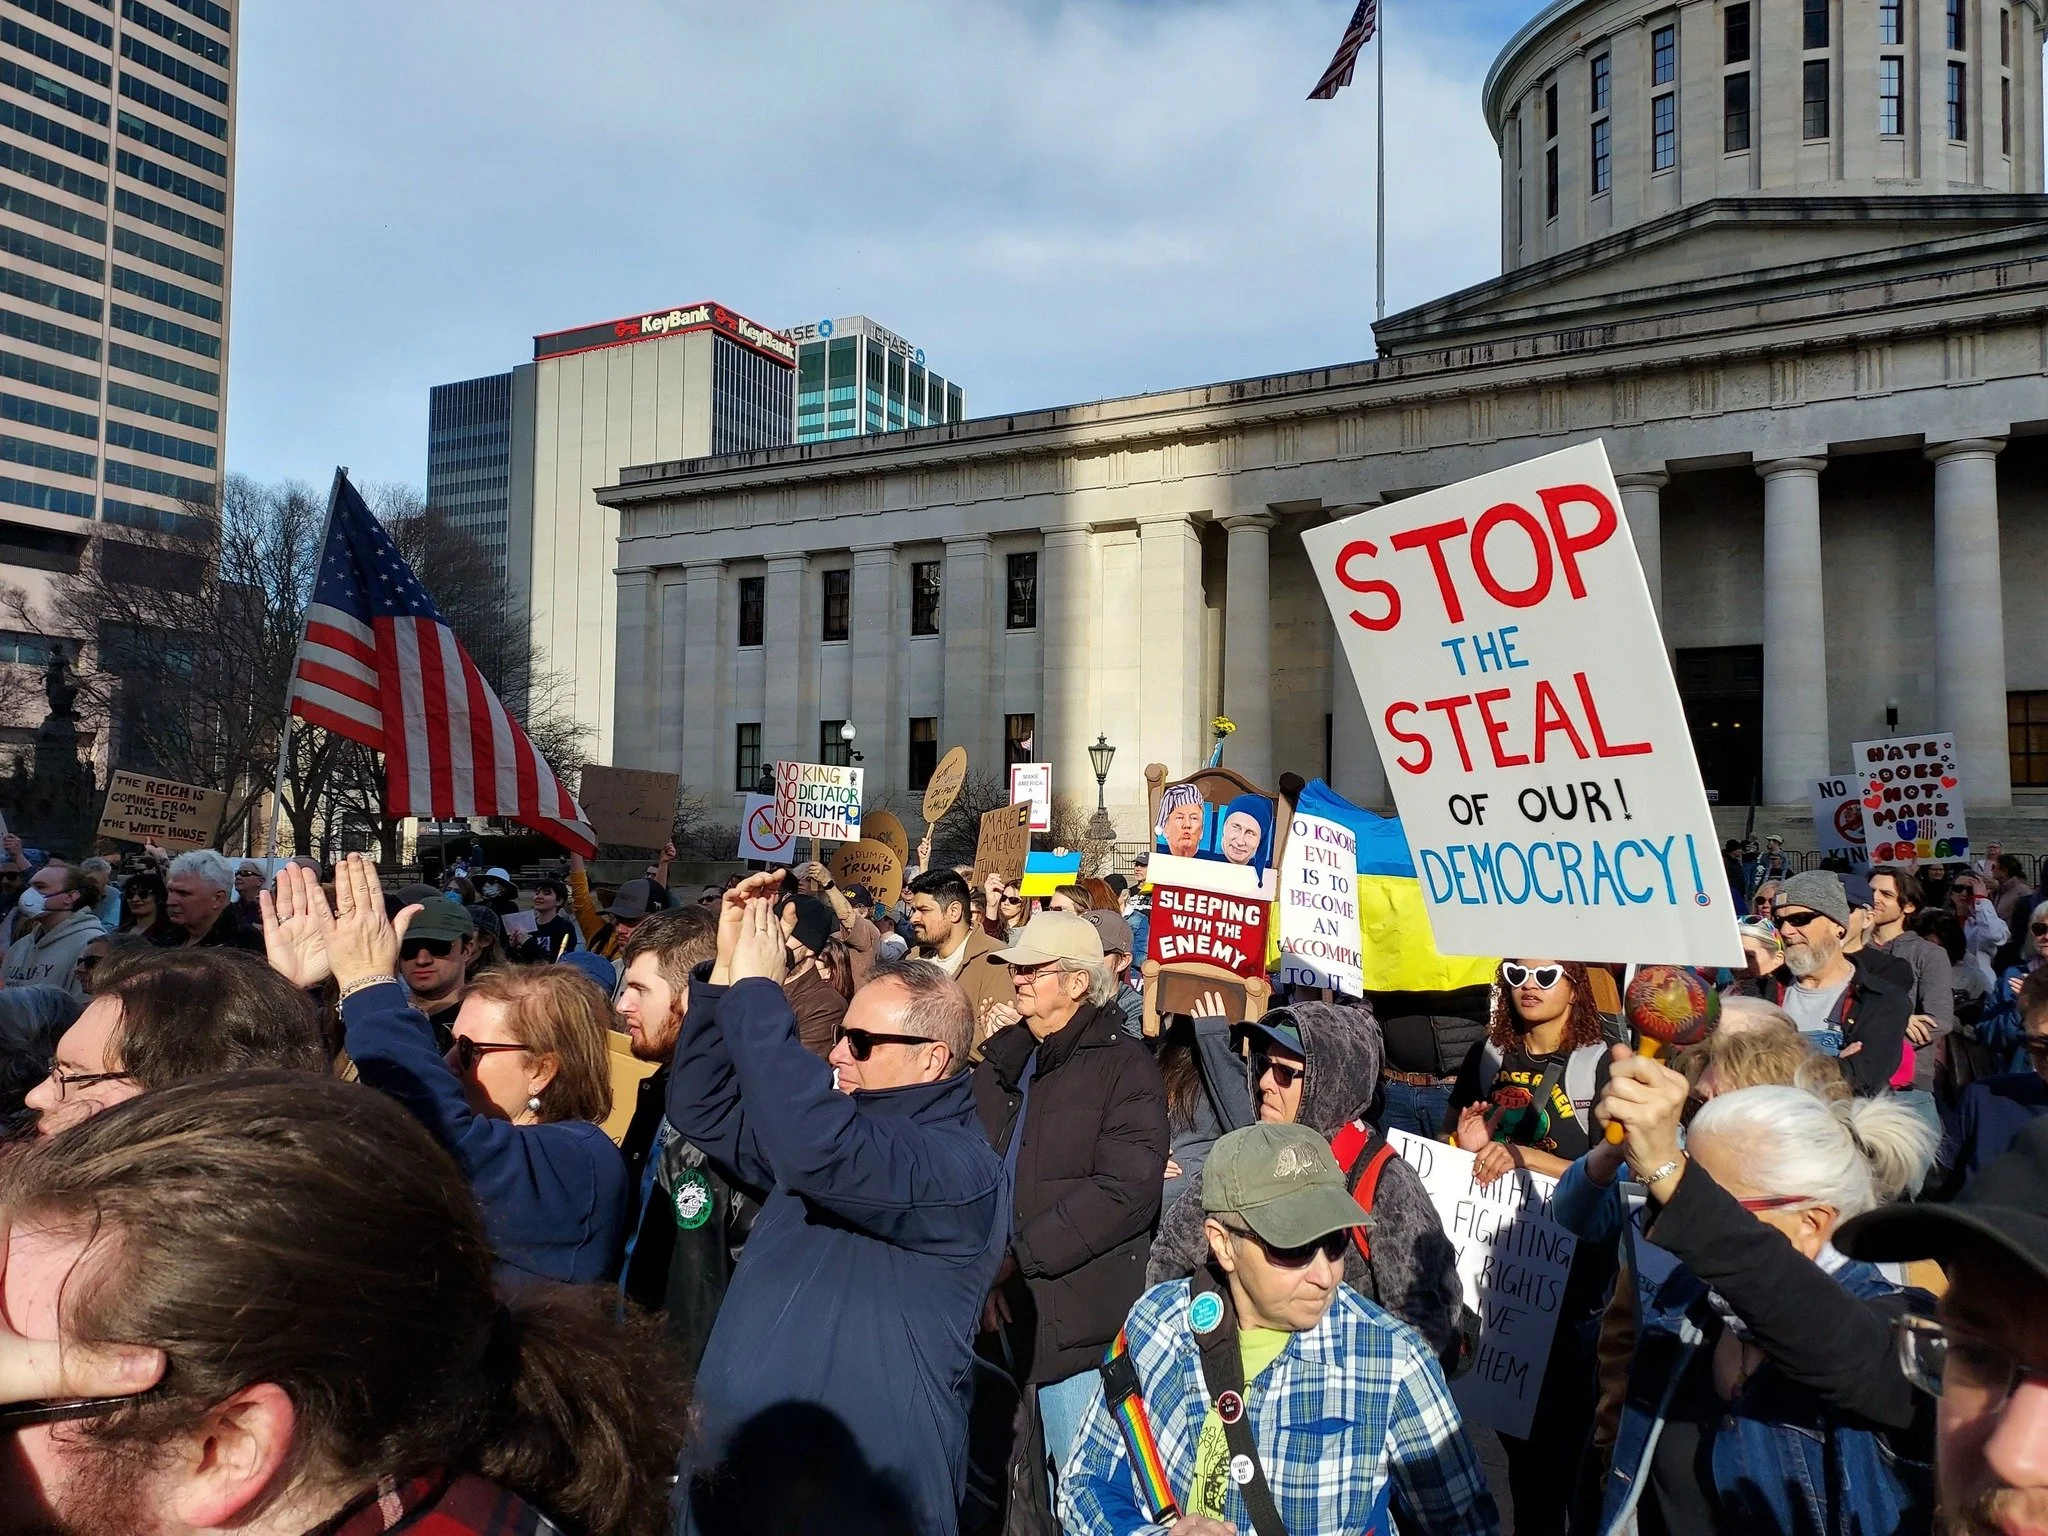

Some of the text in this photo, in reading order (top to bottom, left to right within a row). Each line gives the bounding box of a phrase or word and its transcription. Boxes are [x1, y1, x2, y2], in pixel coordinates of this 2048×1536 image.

[641, 305, 709, 333] KeyBank
[738, 317, 795, 361] KeyBank
[874, 326, 915, 360] CHASE
[1335, 484, 1618, 631] STOP
[1441, 625, 1529, 676] THE
[1384, 672, 1653, 774] STEAL
[1867, 742, 1938, 762] HATE
[777, 762, 841, 785] NO KING
[1878, 763, 1944, 783] DOES
[116, 776, 205, 801] THE REICH IS
[777, 781, 859, 804] NO DICTATOR
[1818, 780, 1847, 799] NO
[1883, 784, 1938, 803] NOT
[111, 792, 196, 815] COMING FROM
[125, 805, 178, 822] INSIDE
[775, 799, 846, 820] NO TRUMP
[1448, 778, 1633, 826] OF OUR!
[1873, 803, 1949, 826] MAKE
[102, 819, 207, 842] THE WHITE HOUSE
[774, 817, 848, 838] NO PUTIN
[982, 810, 1016, 833] MAKE
[980, 832, 1022, 854] AMERICA
[1313, 824, 1357, 855] IGNORE
[1870, 837, 1969, 863] GREAT
[1304, 845, 1341, 869] EVIL
[1828, 846, 1869, 863] KIN
[840, 862, 892, 877] TRUMP
[1302, 868, 1349, 893] IS TO
[1419, 834, 1711, 907] DEMOCRACY!
[1159, 890, 1261, 926] SLEEPING
[1290, 889, 1354, 920] BECOME
[1172, 914, 1243, 939] WITH THE
[1313, 917, 1339, 937] AN
[1159, 934, 1247, 969] ENEMY
[1280, 936, 1363, 969] ACCOMPLICE
[1286, 967, 1316, 987] TO
[1327, 972, 1344, 992] IT
[1402, 1137, 1433, 1179] I'D
[1454, 1200, 1571, 1269] FIGHTING
[1480, 1254, 1562, 1313] RIGHTS
